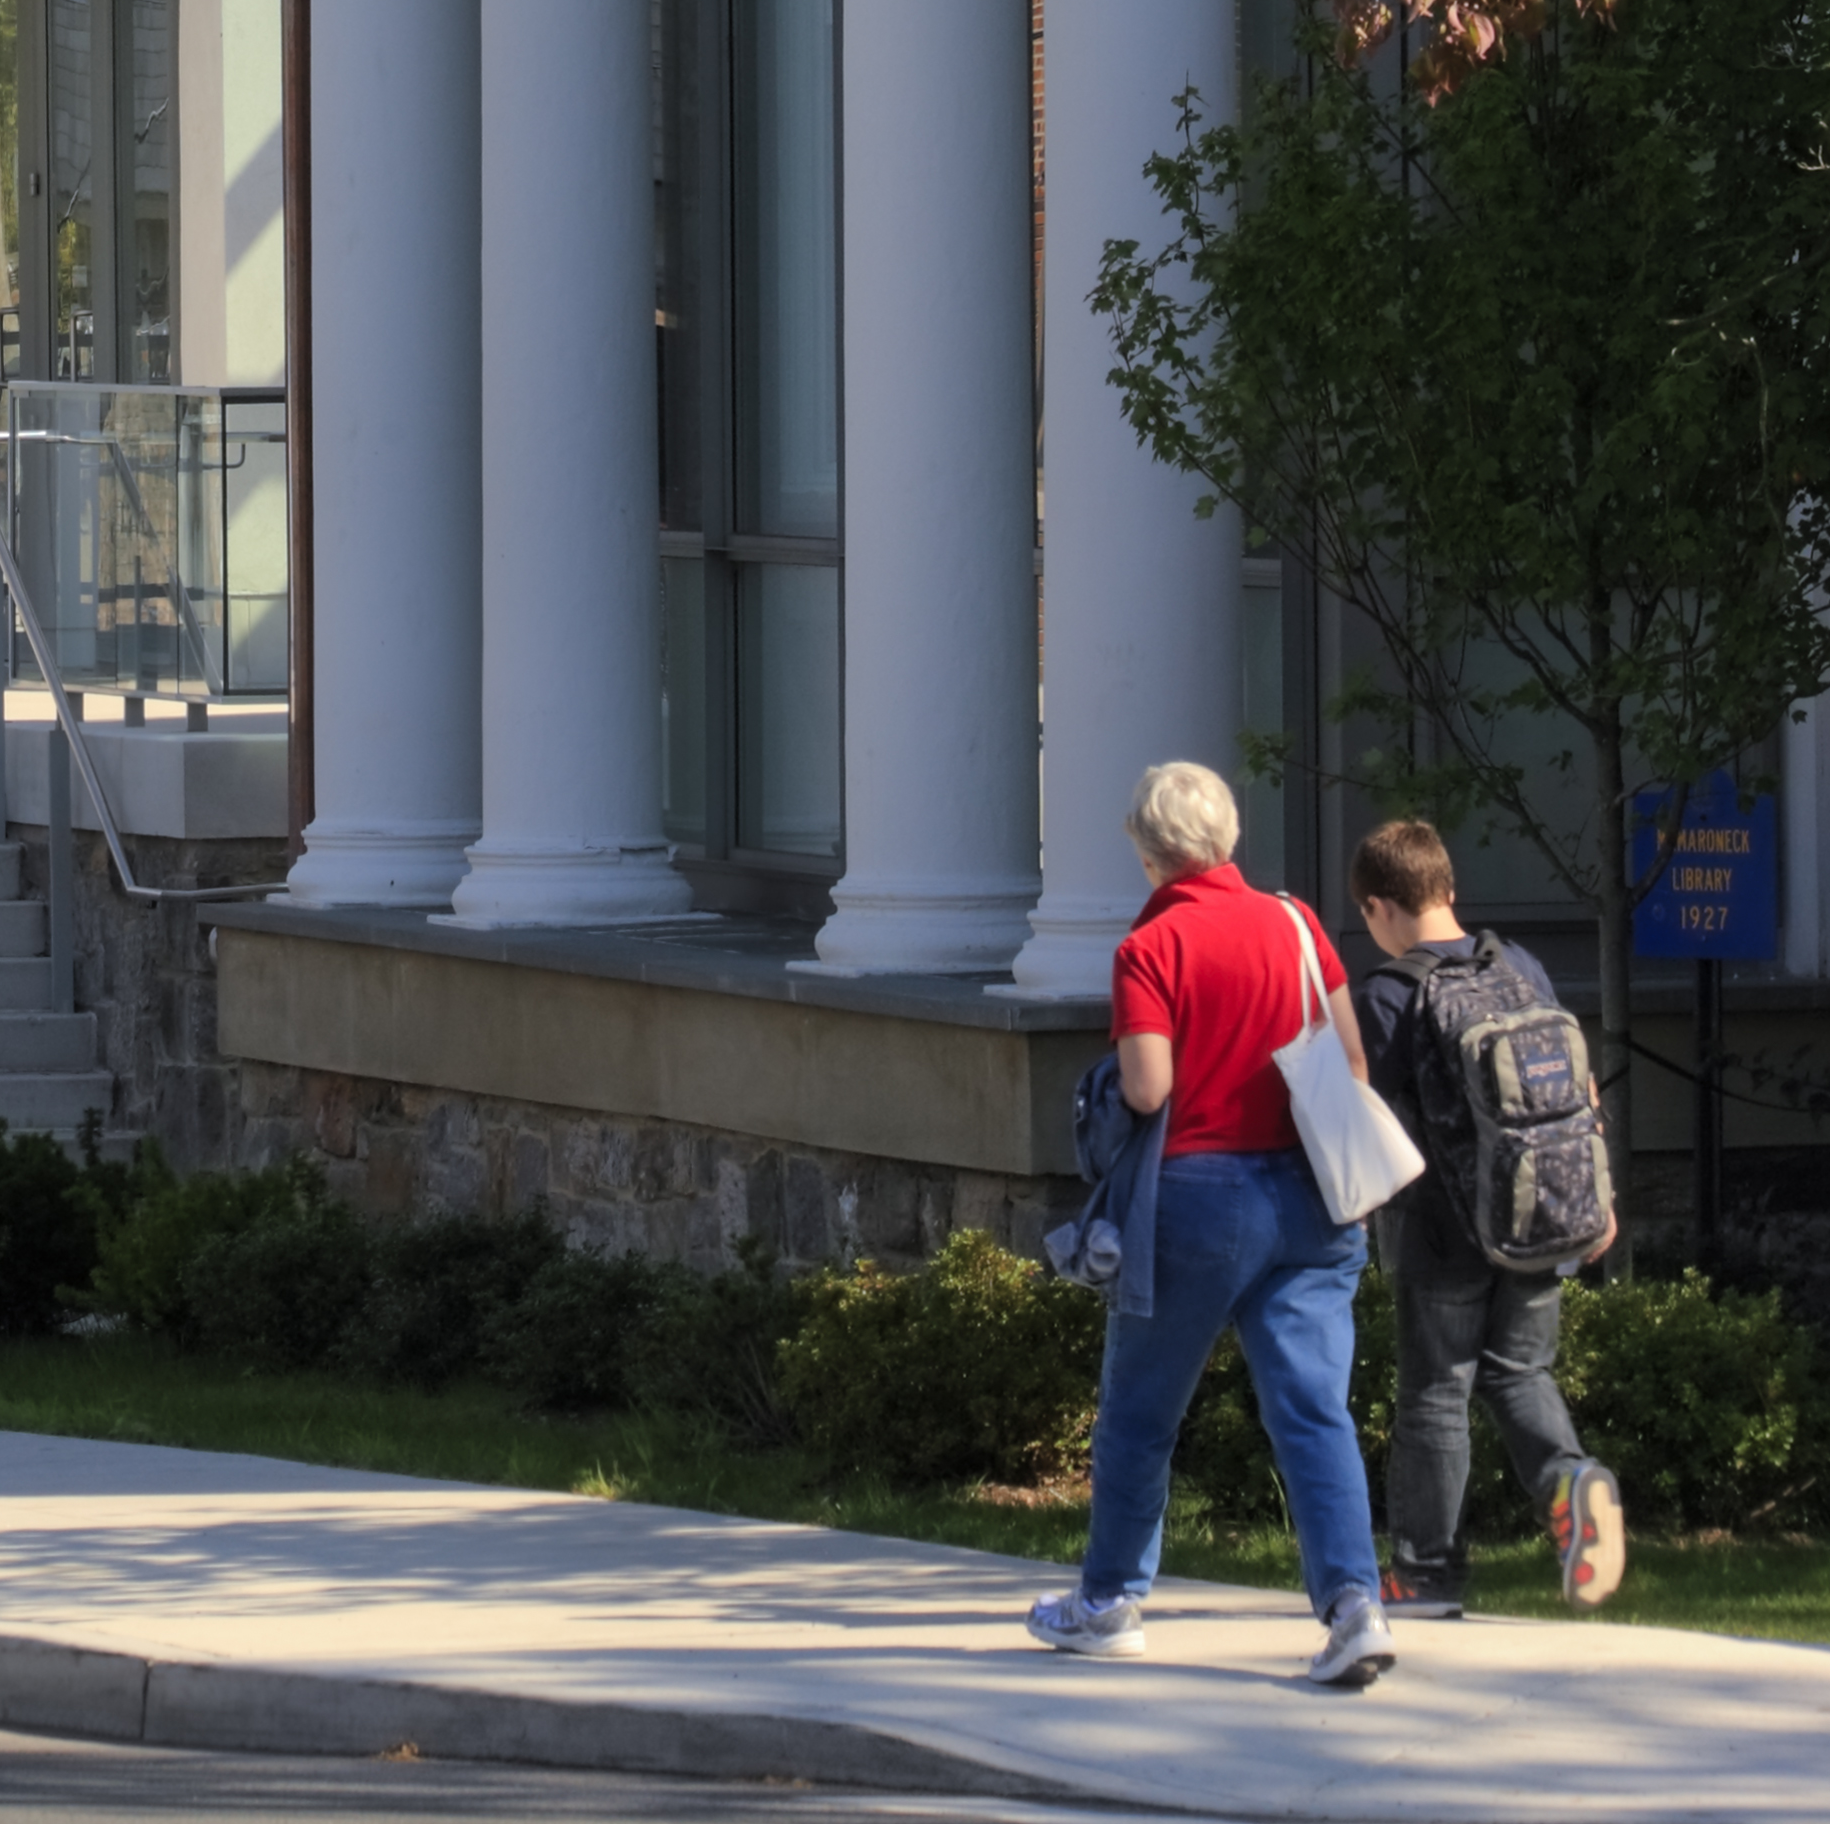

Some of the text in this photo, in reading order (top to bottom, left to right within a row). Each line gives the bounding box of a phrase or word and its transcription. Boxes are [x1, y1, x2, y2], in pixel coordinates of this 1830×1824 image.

[1657, 828, 1750, 853] MMARONECK
[1672, 867, 1732, 892] LIBRARY
[1681, 905, 1728, 931] 1927
